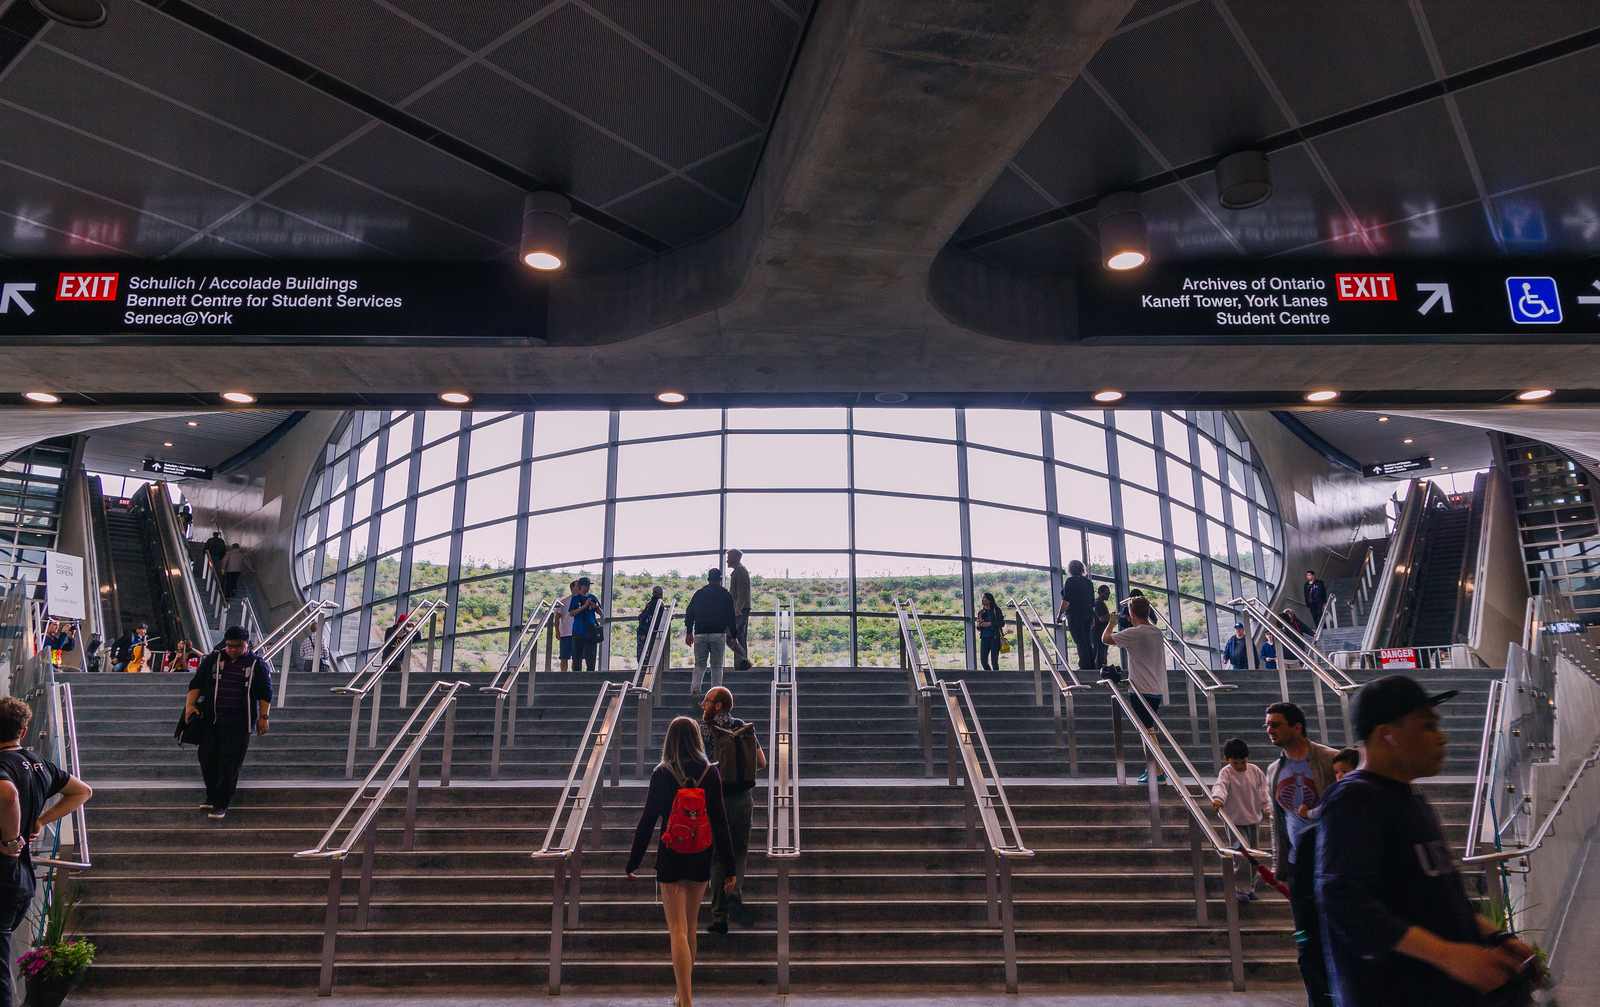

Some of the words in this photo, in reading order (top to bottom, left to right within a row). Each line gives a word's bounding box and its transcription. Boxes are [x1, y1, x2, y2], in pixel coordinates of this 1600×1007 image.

[60, 276, 116, 298] EXIT
[128, 276, 196, 291] Schulich
[198, 276, 207, 291] /
[208, 276, 282, 291] Accolade
[285, 277, 358, 292] Buildings
[1182, 277, 1248, 291] Archives
[1251, 277, 1267, 291] of
[1269, 277, 1326, 291] Ontario
[1338, 276, 1392, 298] EXIT
[126, 294, 187, 308] Bennett
[190, 294, 243, 308] Centre
[246, 294, 269, 308] for
[271, 294, 333, 308] Student
[336, 294, 402, 309] Services
[1141, 295, 1191, 308] Kaneff
[1192, 295, 1242, 310] Tower,
[1244, 295, 1280, 308] York
[1282, 295, 1328, 308] Lanes
[123, 311, 233, 326] Seneca@York
[1216, 311, 1276, 325] Student
[1279, 311, 1330, 325] Centre
[56, 569, 73, 577] OPEN
[1381, 649, 1414, 658] DANGER
